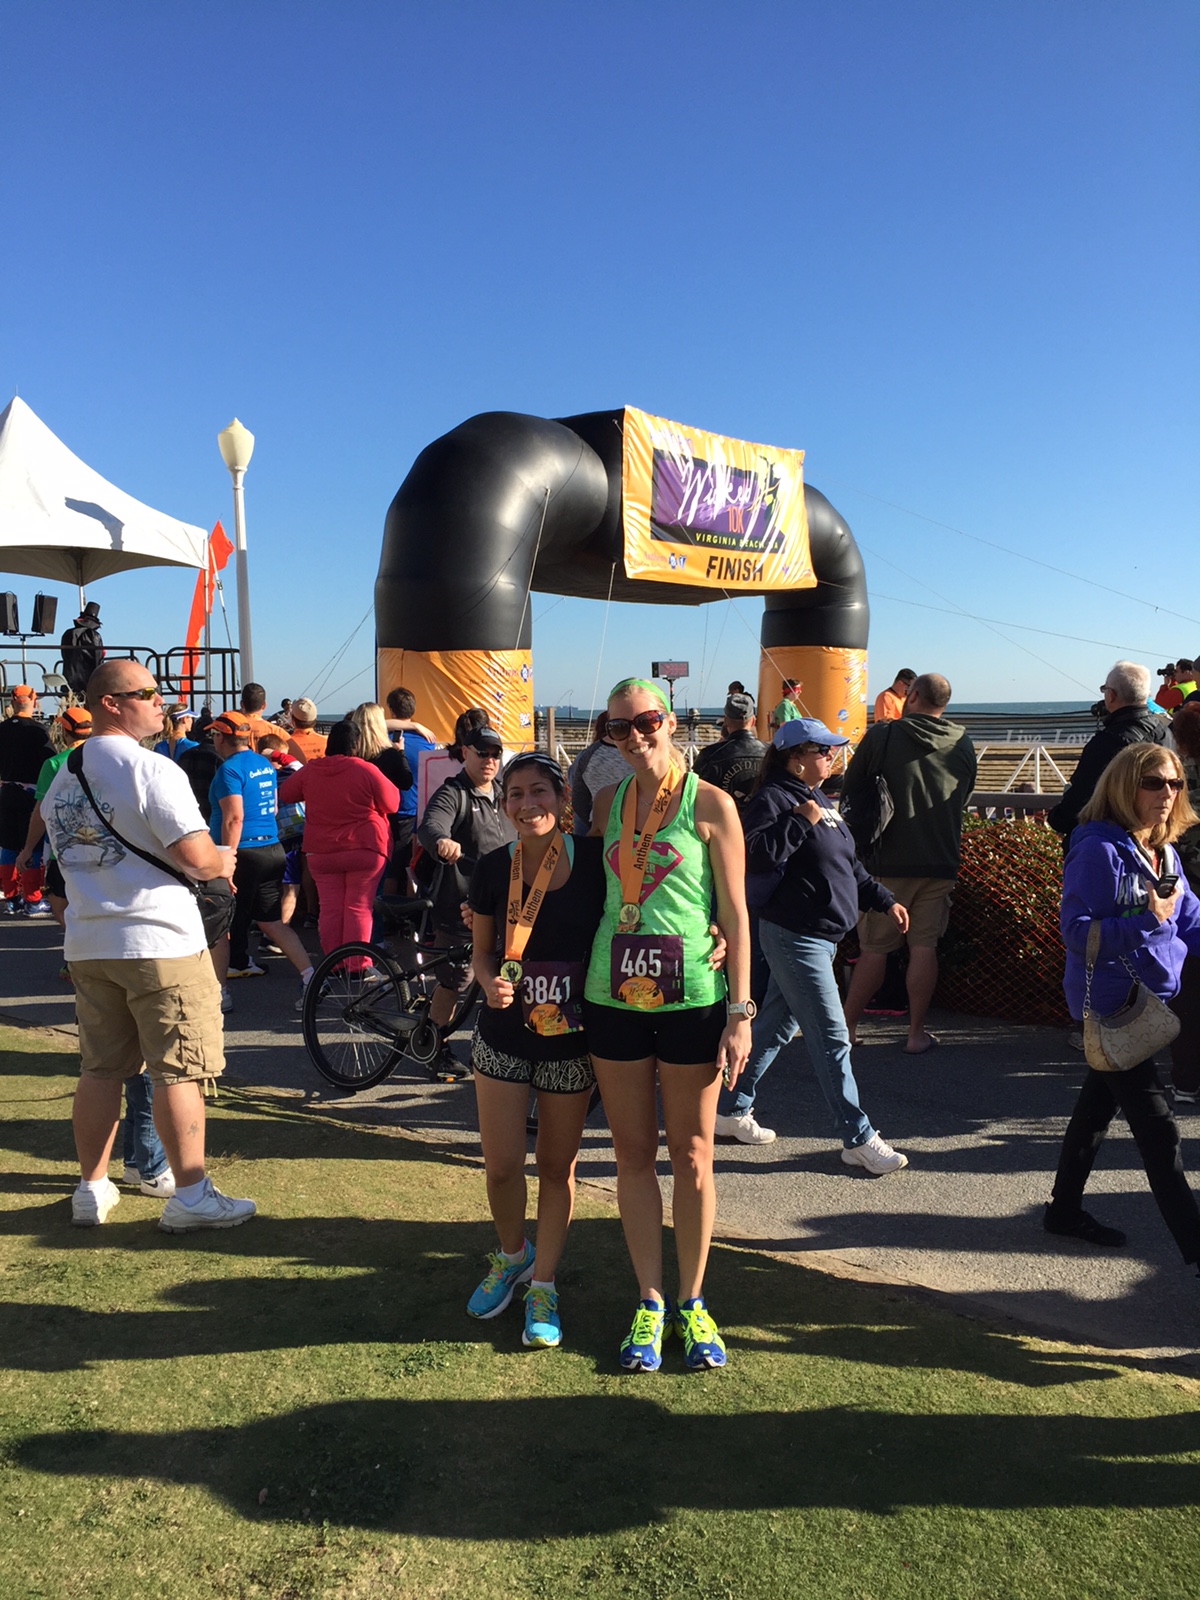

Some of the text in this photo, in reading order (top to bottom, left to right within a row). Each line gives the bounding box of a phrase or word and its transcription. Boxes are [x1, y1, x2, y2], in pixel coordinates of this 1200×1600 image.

[677, 458, 757, 526] Wiked
[727, 506, 744, 534] 10K
[695, 533, 736, 546] VIRGINIA
[706, 555, 764, 582] FINISH
[633, 833, 653, 870] Anthem
[522, 888, 543, 922] Anthem
[620, 948, 662, 977] 465
[523, 975, 571, 1004] 3841
[573, 1004, 582, 1014] 15
